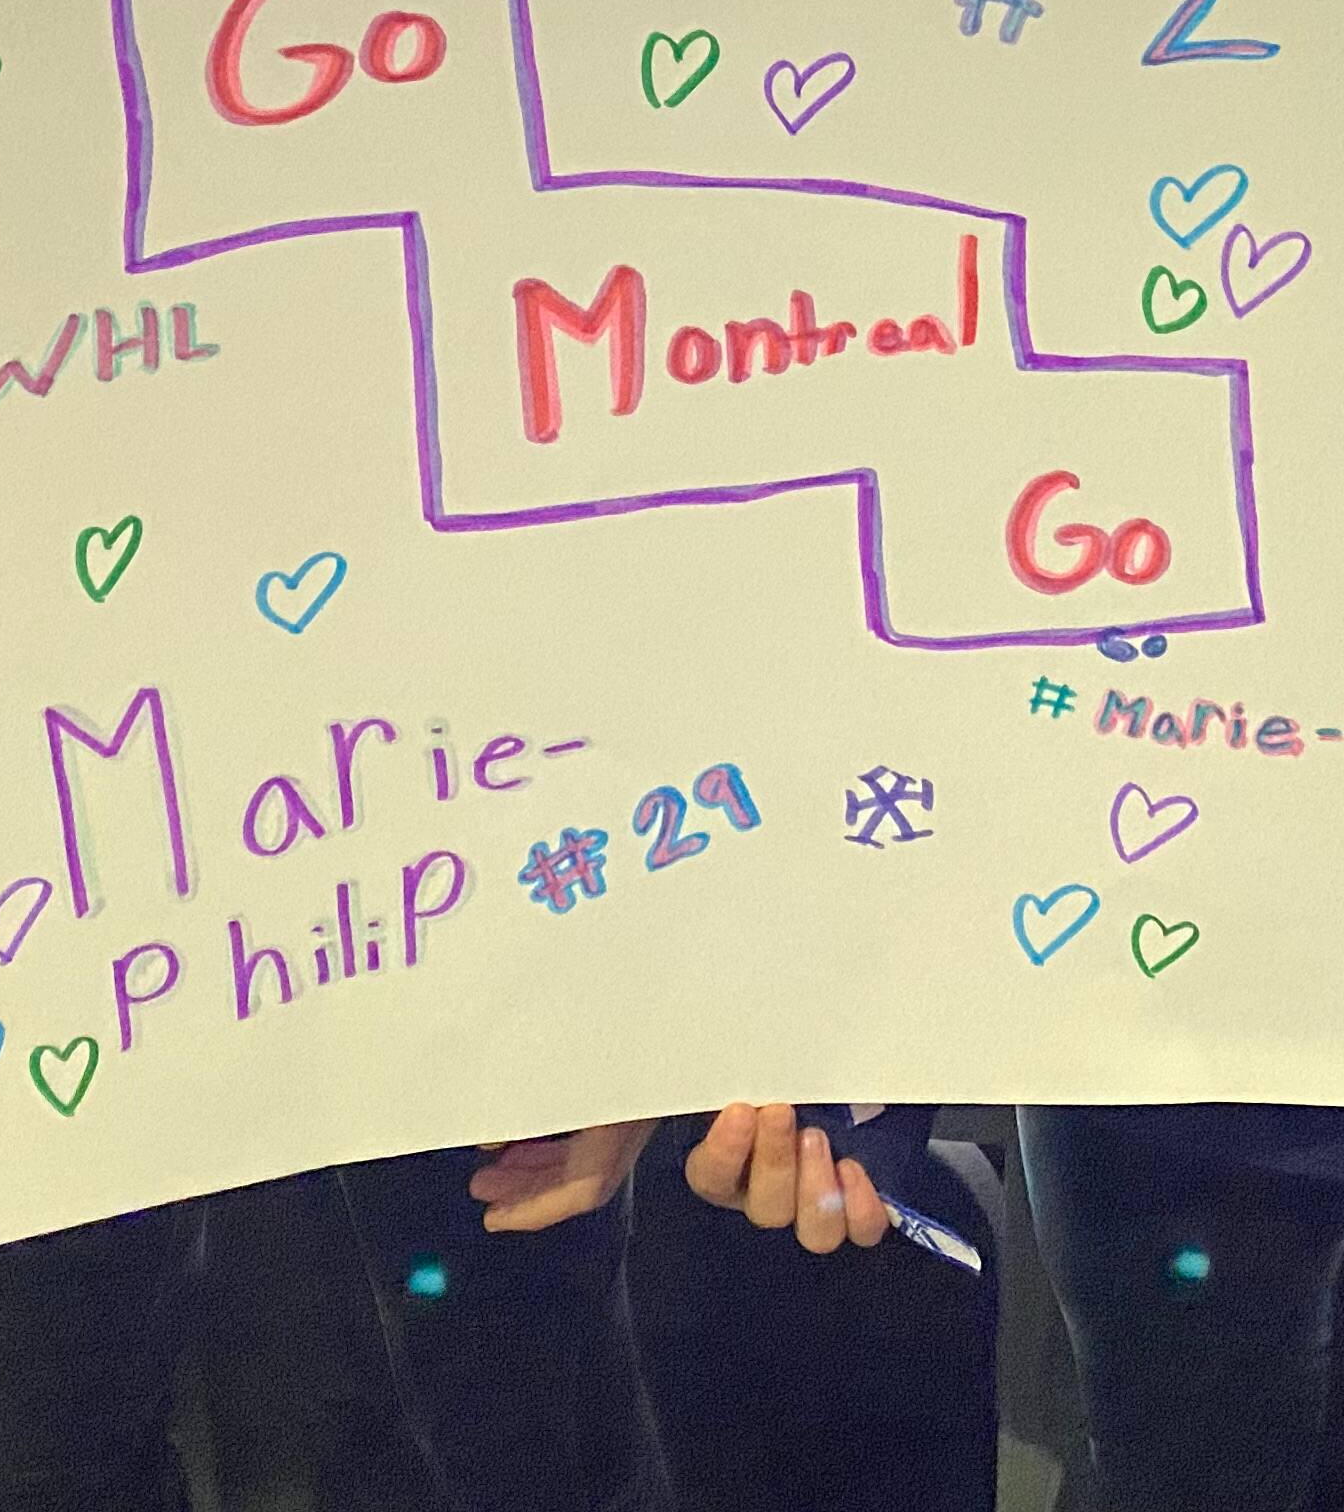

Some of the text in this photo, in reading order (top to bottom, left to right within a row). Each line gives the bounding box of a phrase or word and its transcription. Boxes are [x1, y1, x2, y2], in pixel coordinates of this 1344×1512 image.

[512, 233, 980, 445] Montreal
[1006, 469, 1172, 596] Go
[44, 687, 590, 919] Marie-
